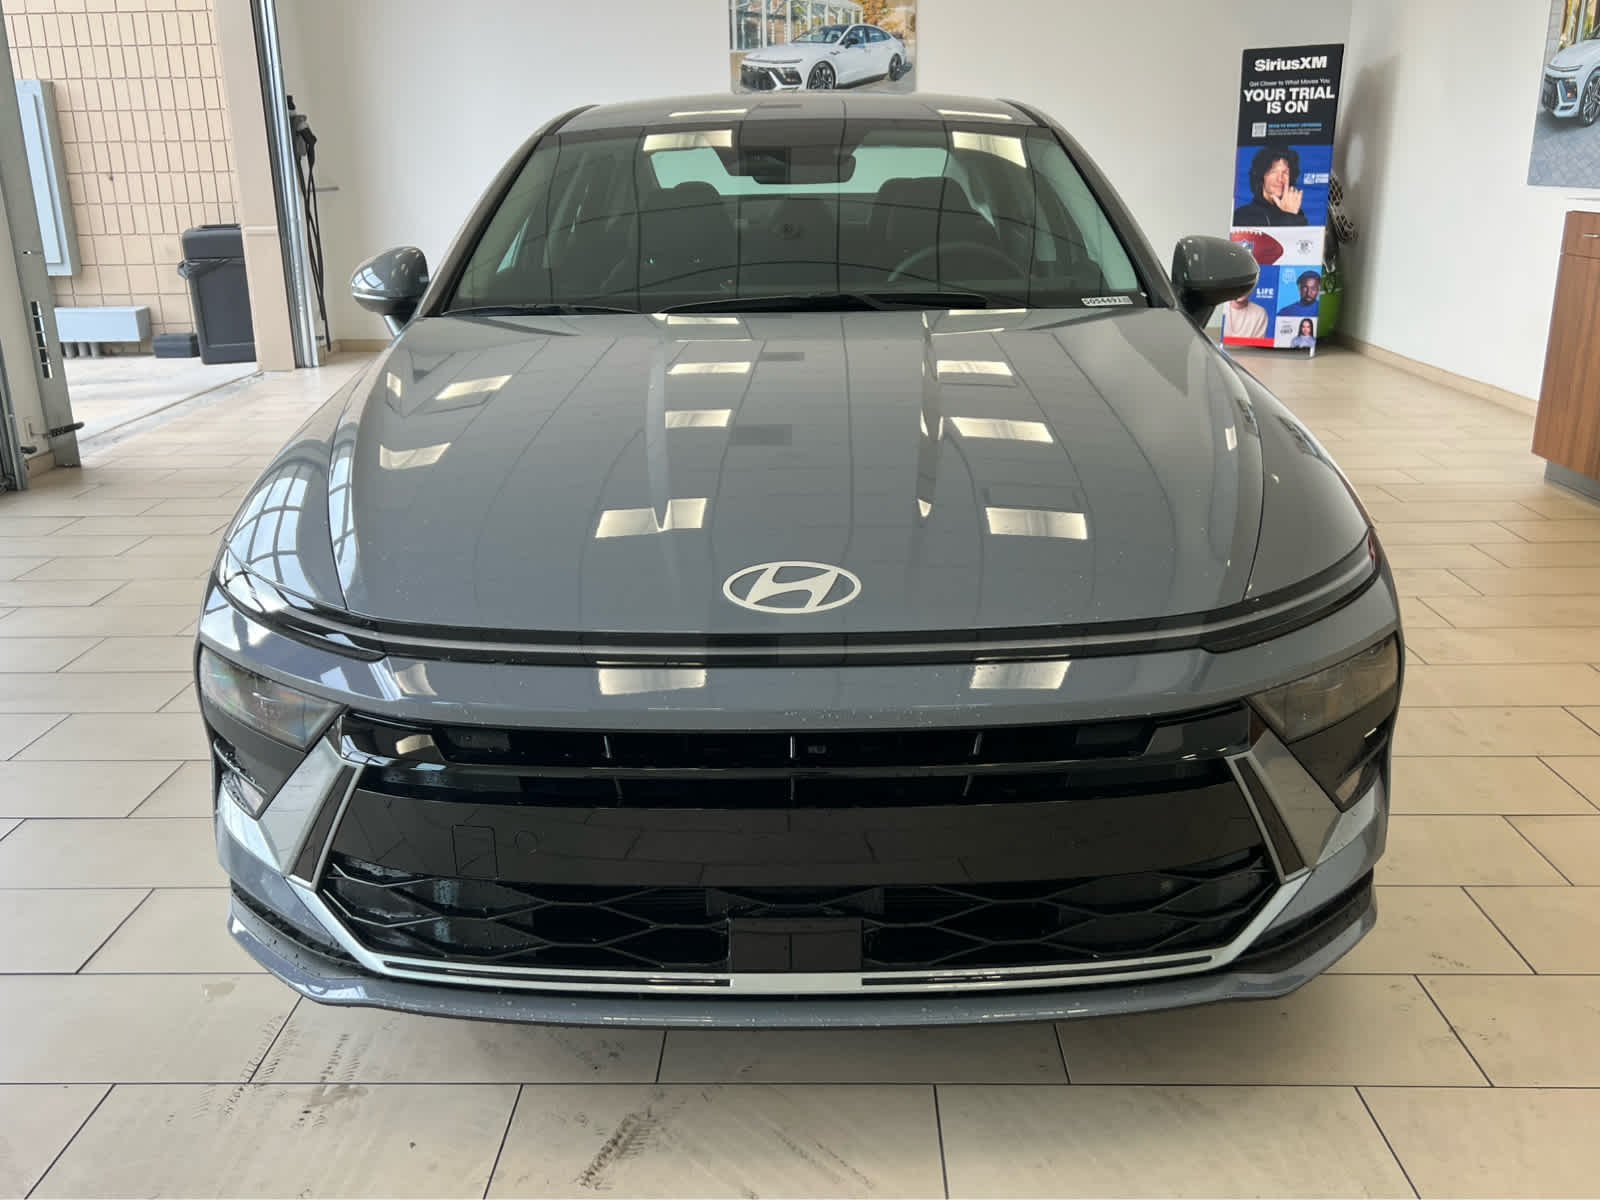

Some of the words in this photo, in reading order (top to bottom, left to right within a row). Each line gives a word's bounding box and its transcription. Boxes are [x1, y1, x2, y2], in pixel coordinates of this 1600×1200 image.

[1254, 56, 1328, 72] SiriusXM
[1244, 88, 1286, 102] YOUR
[1289, 86, 1336, 100] TRIAL
[1266, 101, 1281, 114] IS
[1284, 101, 1309, 113] ON
